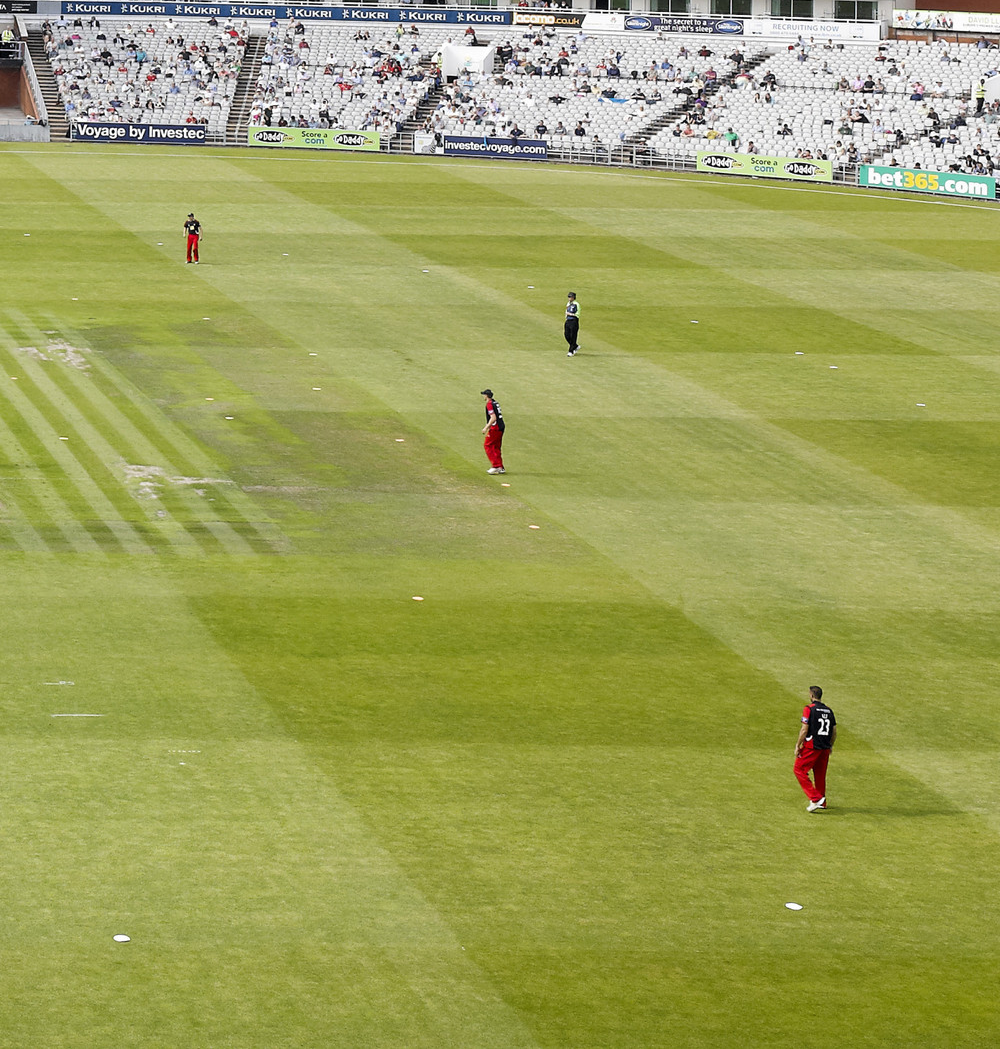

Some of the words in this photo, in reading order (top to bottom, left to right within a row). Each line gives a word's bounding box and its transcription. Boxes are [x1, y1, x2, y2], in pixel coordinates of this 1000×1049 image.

[75, 4, 111, 13] KUKRI
[130, 4, 166, 13] KUKRI
[184, 5, 221, 15] KUKRI
[239, 6, 276, 16] KUKRI
[295, 8, 332, 18] KUKRI
[351, 10, 389, 20] KUKRI
[408, 11, 446, 21] KUKRI
[466, 13, 505, 23] KUKRI
[968, 16, 989, 24] DAVID
[772, 23, 818, 32] RECRUITING
[820, 25, 840, 33] NOW
[78, 124, 126, 139] Voyage
[129, 125, 146, 140] by
[149, 126, 205, 139] Investec
[751, 158, 772, 166] Score
[868, 167, 988, 196] bet365.com
[817, 718, 831, 735] 23
